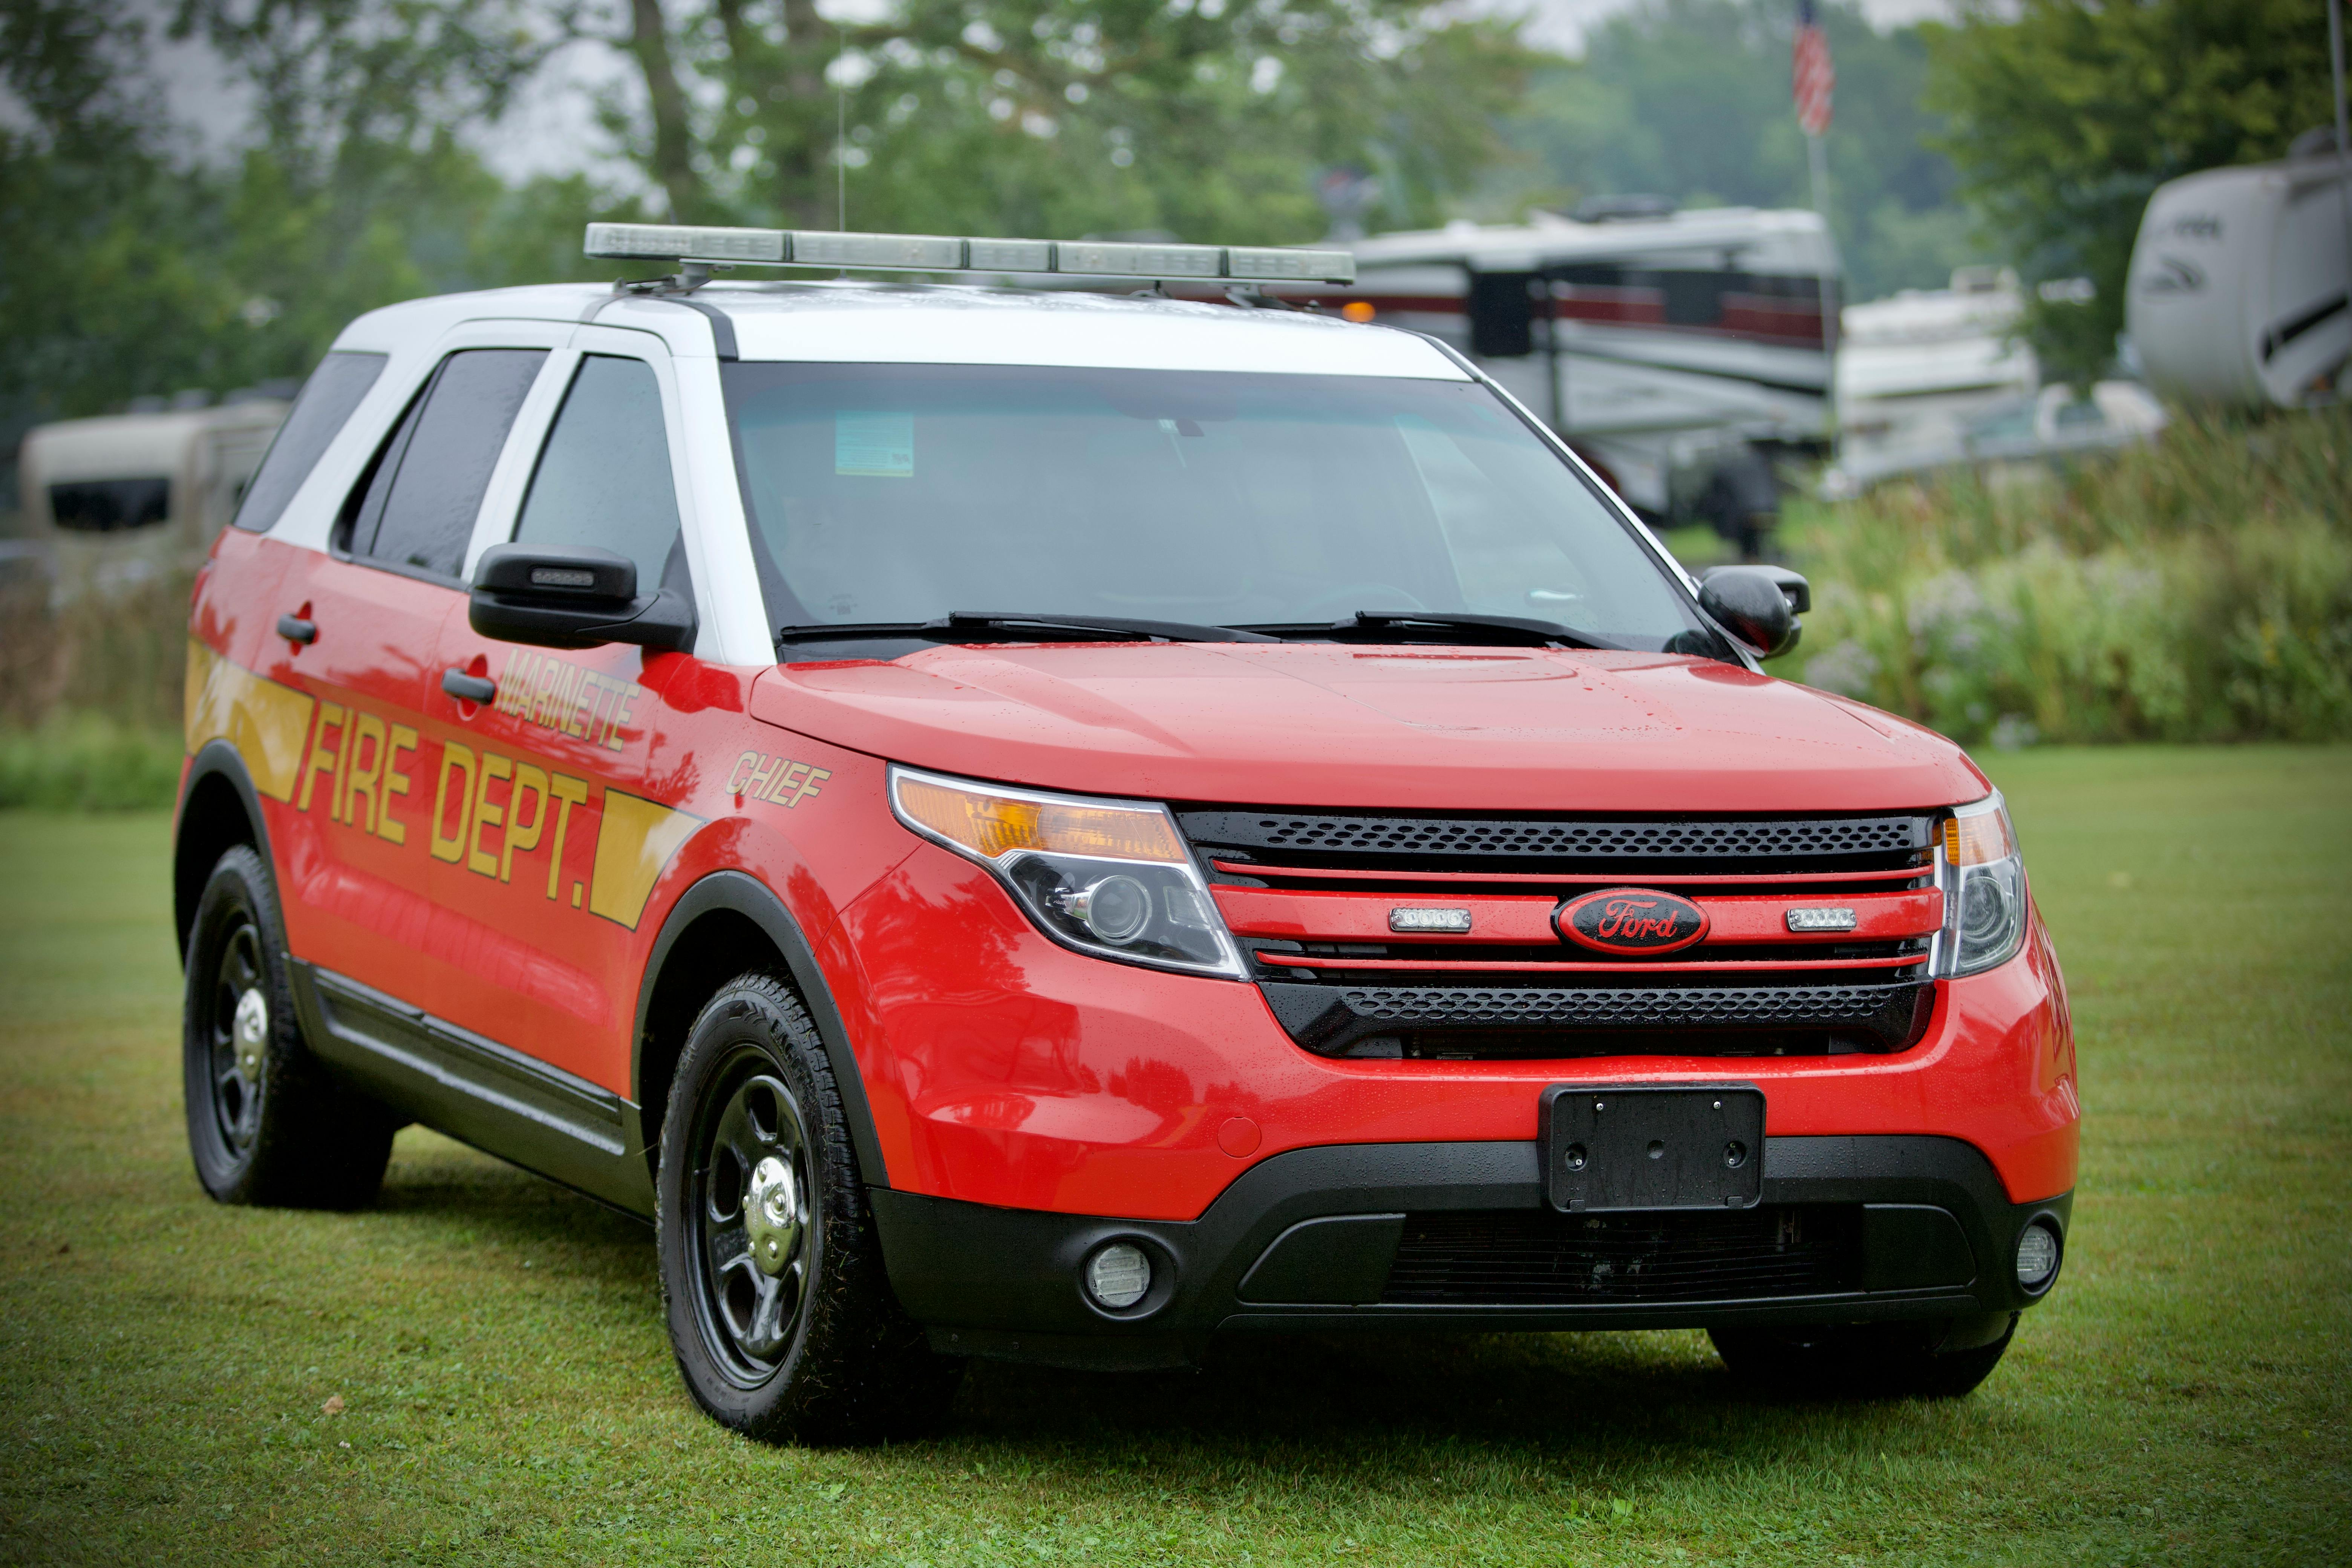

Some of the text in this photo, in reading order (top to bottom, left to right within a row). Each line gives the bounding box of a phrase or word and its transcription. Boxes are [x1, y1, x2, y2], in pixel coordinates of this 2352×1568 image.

[493, 647, 642, 752] MARINETTE
[297, 700, 589, 909] FIRE DEPT.
[725, 750, 832, 808] CHIEF
[1599, 899, 1678, 938] Ford
